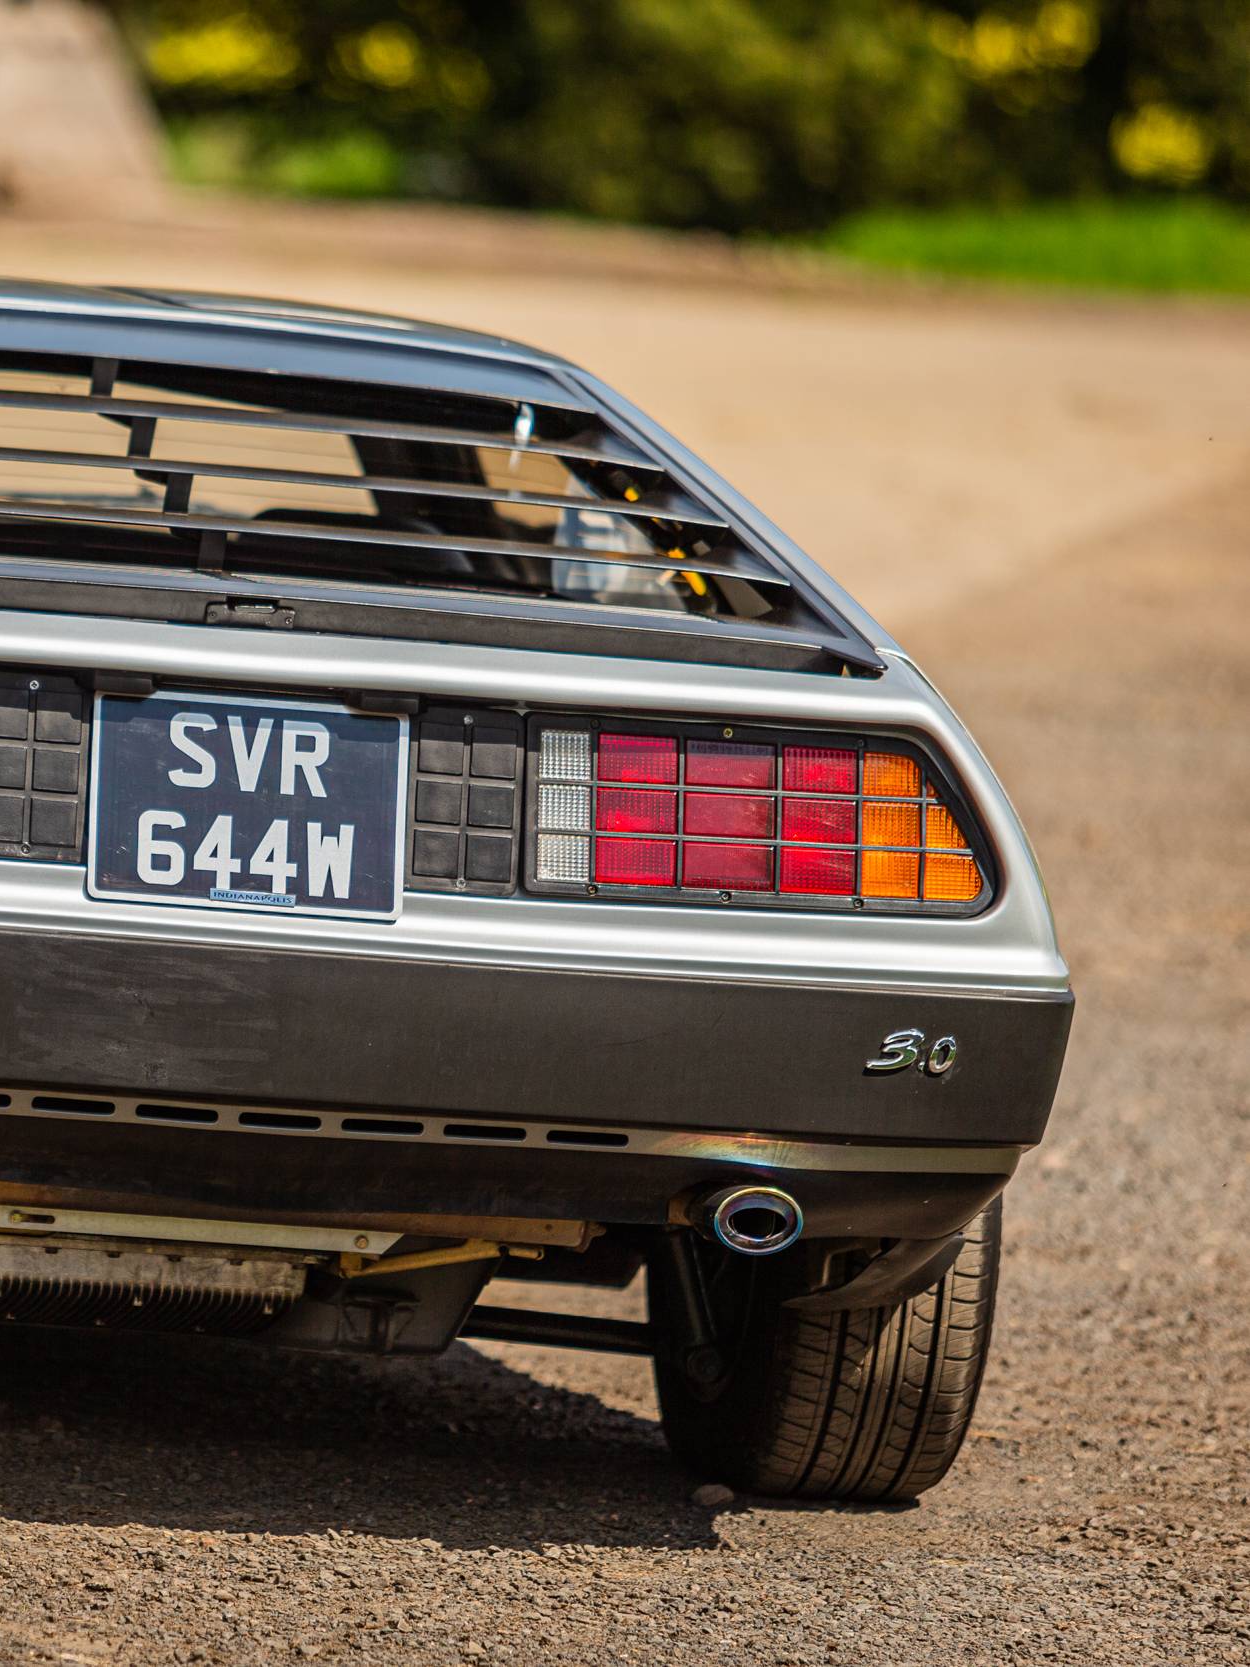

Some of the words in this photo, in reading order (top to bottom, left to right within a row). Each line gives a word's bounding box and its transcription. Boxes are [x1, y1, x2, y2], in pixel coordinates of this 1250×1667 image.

[168, 712, 330, 797] SVR
[137, 810, 355, 899] 644W
[213, 891, 293, 904] INDIANAPOLIS
